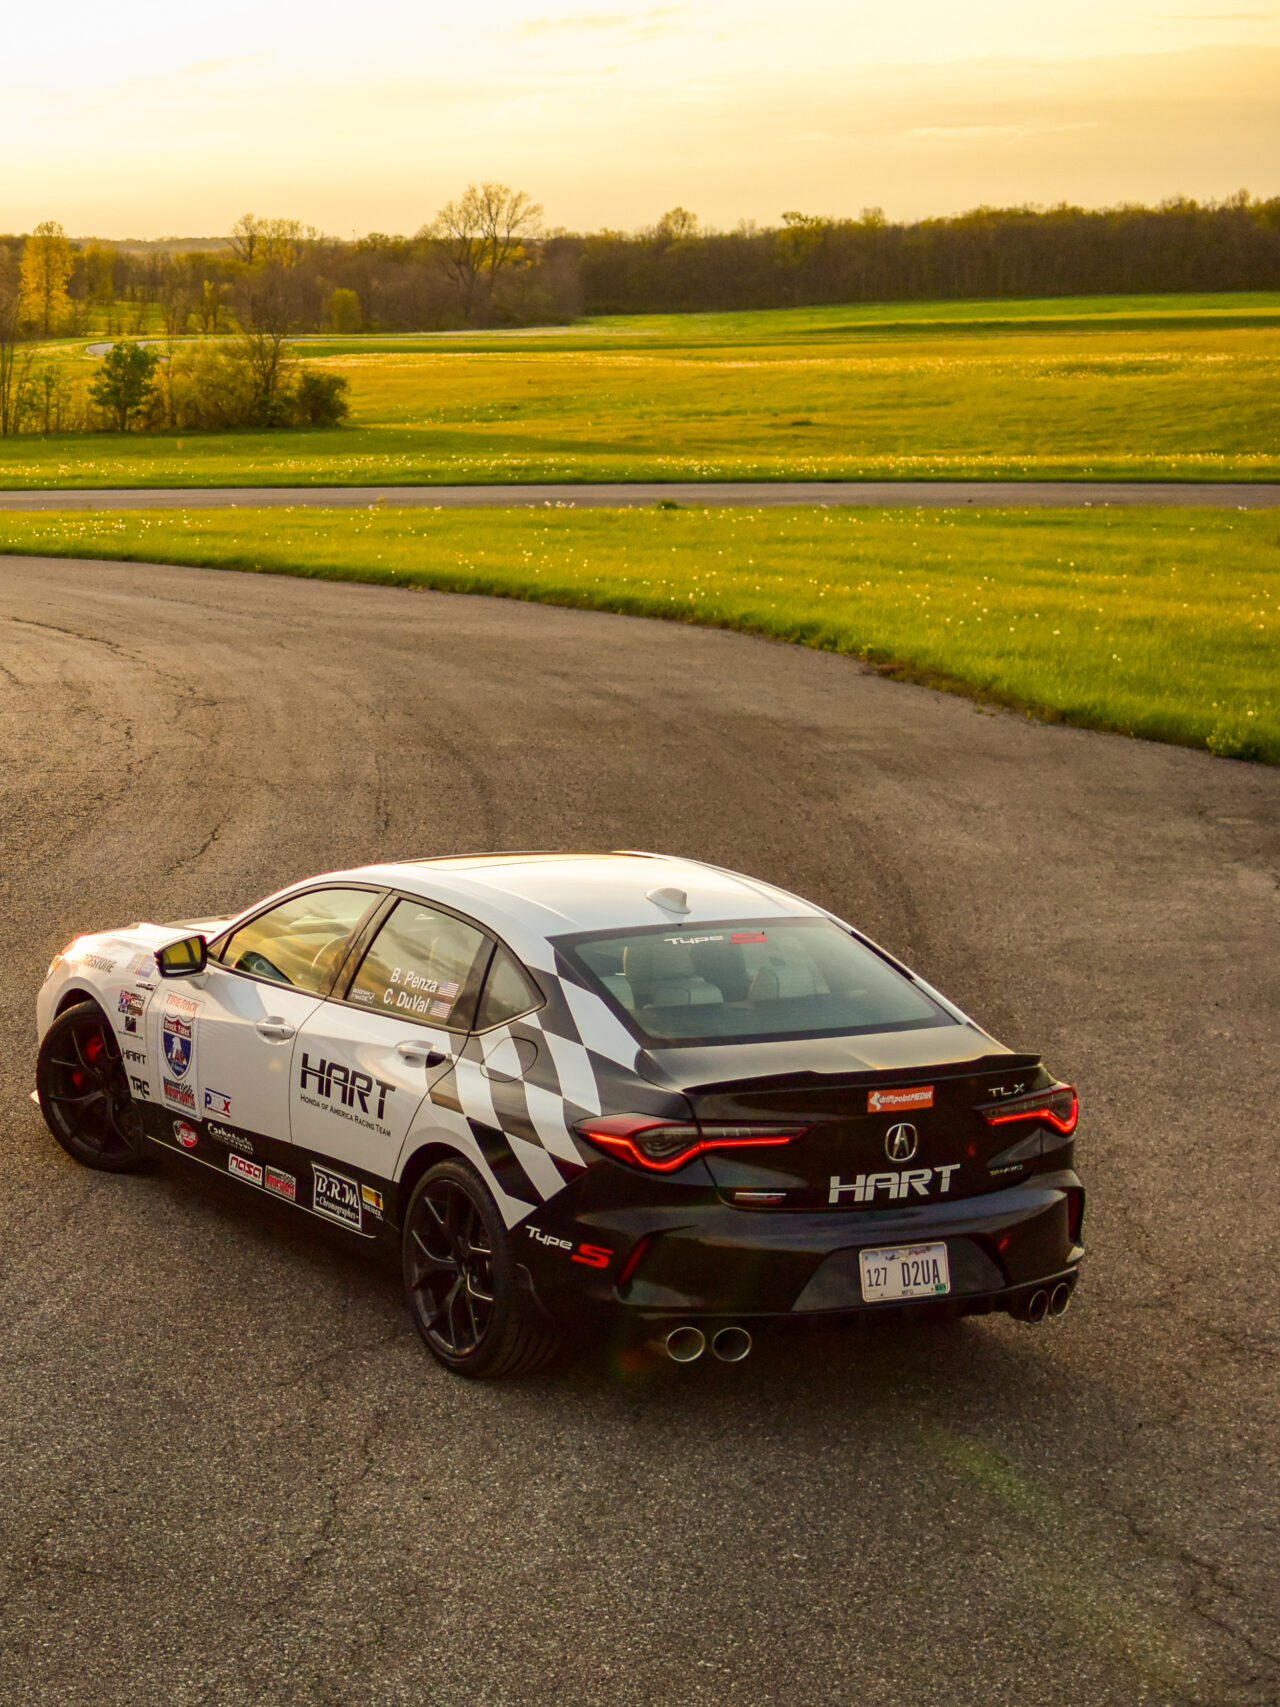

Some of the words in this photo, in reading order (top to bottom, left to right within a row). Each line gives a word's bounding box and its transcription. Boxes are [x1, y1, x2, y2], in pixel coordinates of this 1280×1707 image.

[664, 935, 724, 944] Type
[730, 932, 768, 944] S
[391, 968, 401, 983] B.
[404, 970, 438, 992] Penza
[384, 988, 393, 1005] C.
[396, 991, 431, 1014] DuVal
[122, 1048, 147, 1064] HART
[300, 1052, 397, 1120] HART
[988, 1083, 1024, 1097] TLX
[828, 1164, 961, 1204] HART
[525, 1225, 573, 1250] Type
[571, 1243, 614, 1269] S
[867, 1267, 887, 1288] 127
[901, 1259, 941, 1288] D2UA
